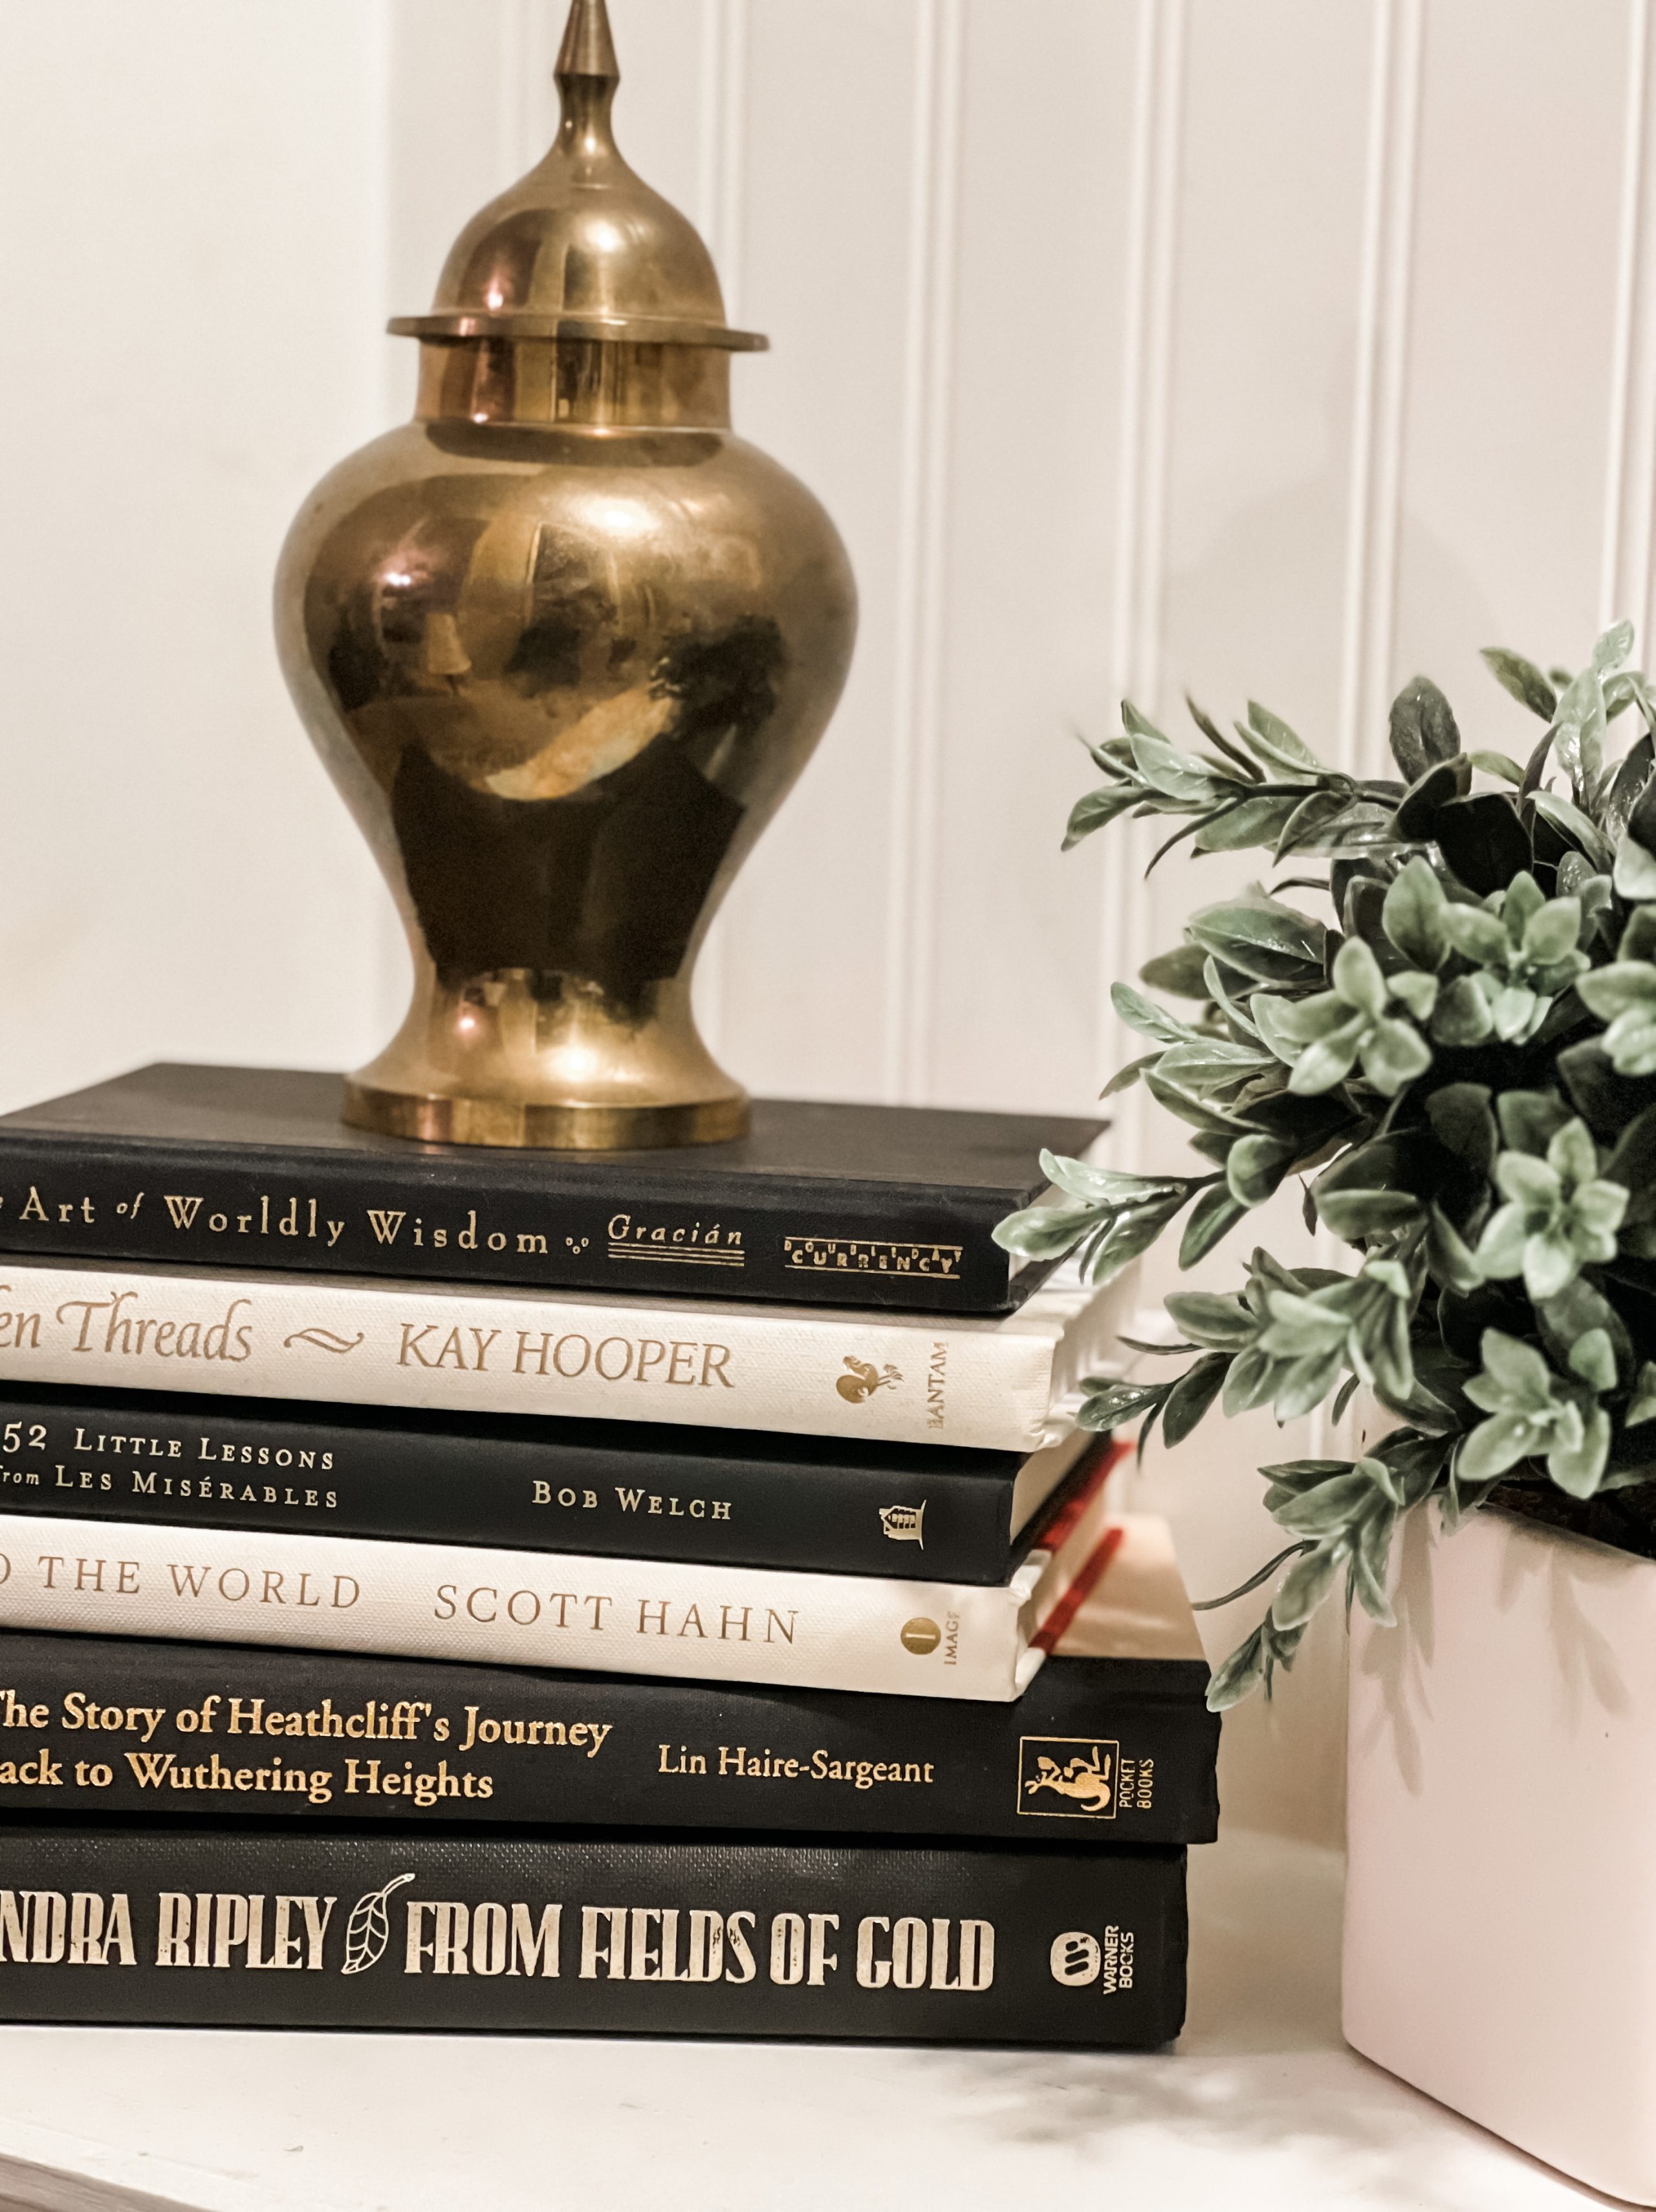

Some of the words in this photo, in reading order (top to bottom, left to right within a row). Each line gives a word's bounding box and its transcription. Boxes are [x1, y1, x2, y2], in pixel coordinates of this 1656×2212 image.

[19, 1186, 95, 1223] Art
[116, 1191, 145, 1219] of
[163, 1195, 345, 1247] Worldly
[367, 1209, 548, 1254] Wisdom
[607, 1214, 742, 1246] Gracián
[0, 1285, 41, 1349] en
[56, 1290, 253, 1363] Threads
[396, 1323, 502, 1372] KAY
[512, 1330, 735, 1389] HOOPER
[926, 1341, 949, 1429] BANTAM
[3, 1421, 47, 1453] 52
[74, 1427, 182, 1458] LITTLE
[198, 1437, 334, 1470] LESSONS
[0, 1465, 39, 1485] rom
[55, 1464, 112, 1490] LES
[132, 1471, 338, 1508] MISÉRABLES
[532, 1480, 598, 1508] BOB
[615, 1487, 732, 1520] WELCH
[38, 1556, 140, 1594] THE
[167, 1564, 360, 1609] WORLD
[434, 1584, 613, 1631] SCOTT
[636, 1599, 800, 1644] HAHN
[944, 1610, 960, 1665] IMAGE
[61, 1692, 166, 1742] Story
[176, 1695, 221, 1733] of
[227, 1698, 450, 1742] Heathcliff's
[458, 1706, 613, 1758] Journey
[0, 1748, 63, 1786] ack
[74, 1760, 113, 1786] to
[124, 1752, 332, 1804] Wuthering
[344, 1759, 494, 1807] Heights
[658, 1744, 707, 1775] Lin
[718, 1746, 935, 1790] Haire-Sargeant
[1118, 1758, 1135, 1808] POCKET
[1137, 1758, 1154, 1809] BOOKS
[0, 1889, 137, 1966] NDRA
[155, 1892, 338, 1970] RIPLEY
[404, 1901, 563, 1978] FROM
[578, 1905, 756, 1984] FIELDS
[770, 1913, 840, 1986] OF
[856, 1916, 995, 1991] GOLD
[1103, 1925, 1119, 1995] WARNER
